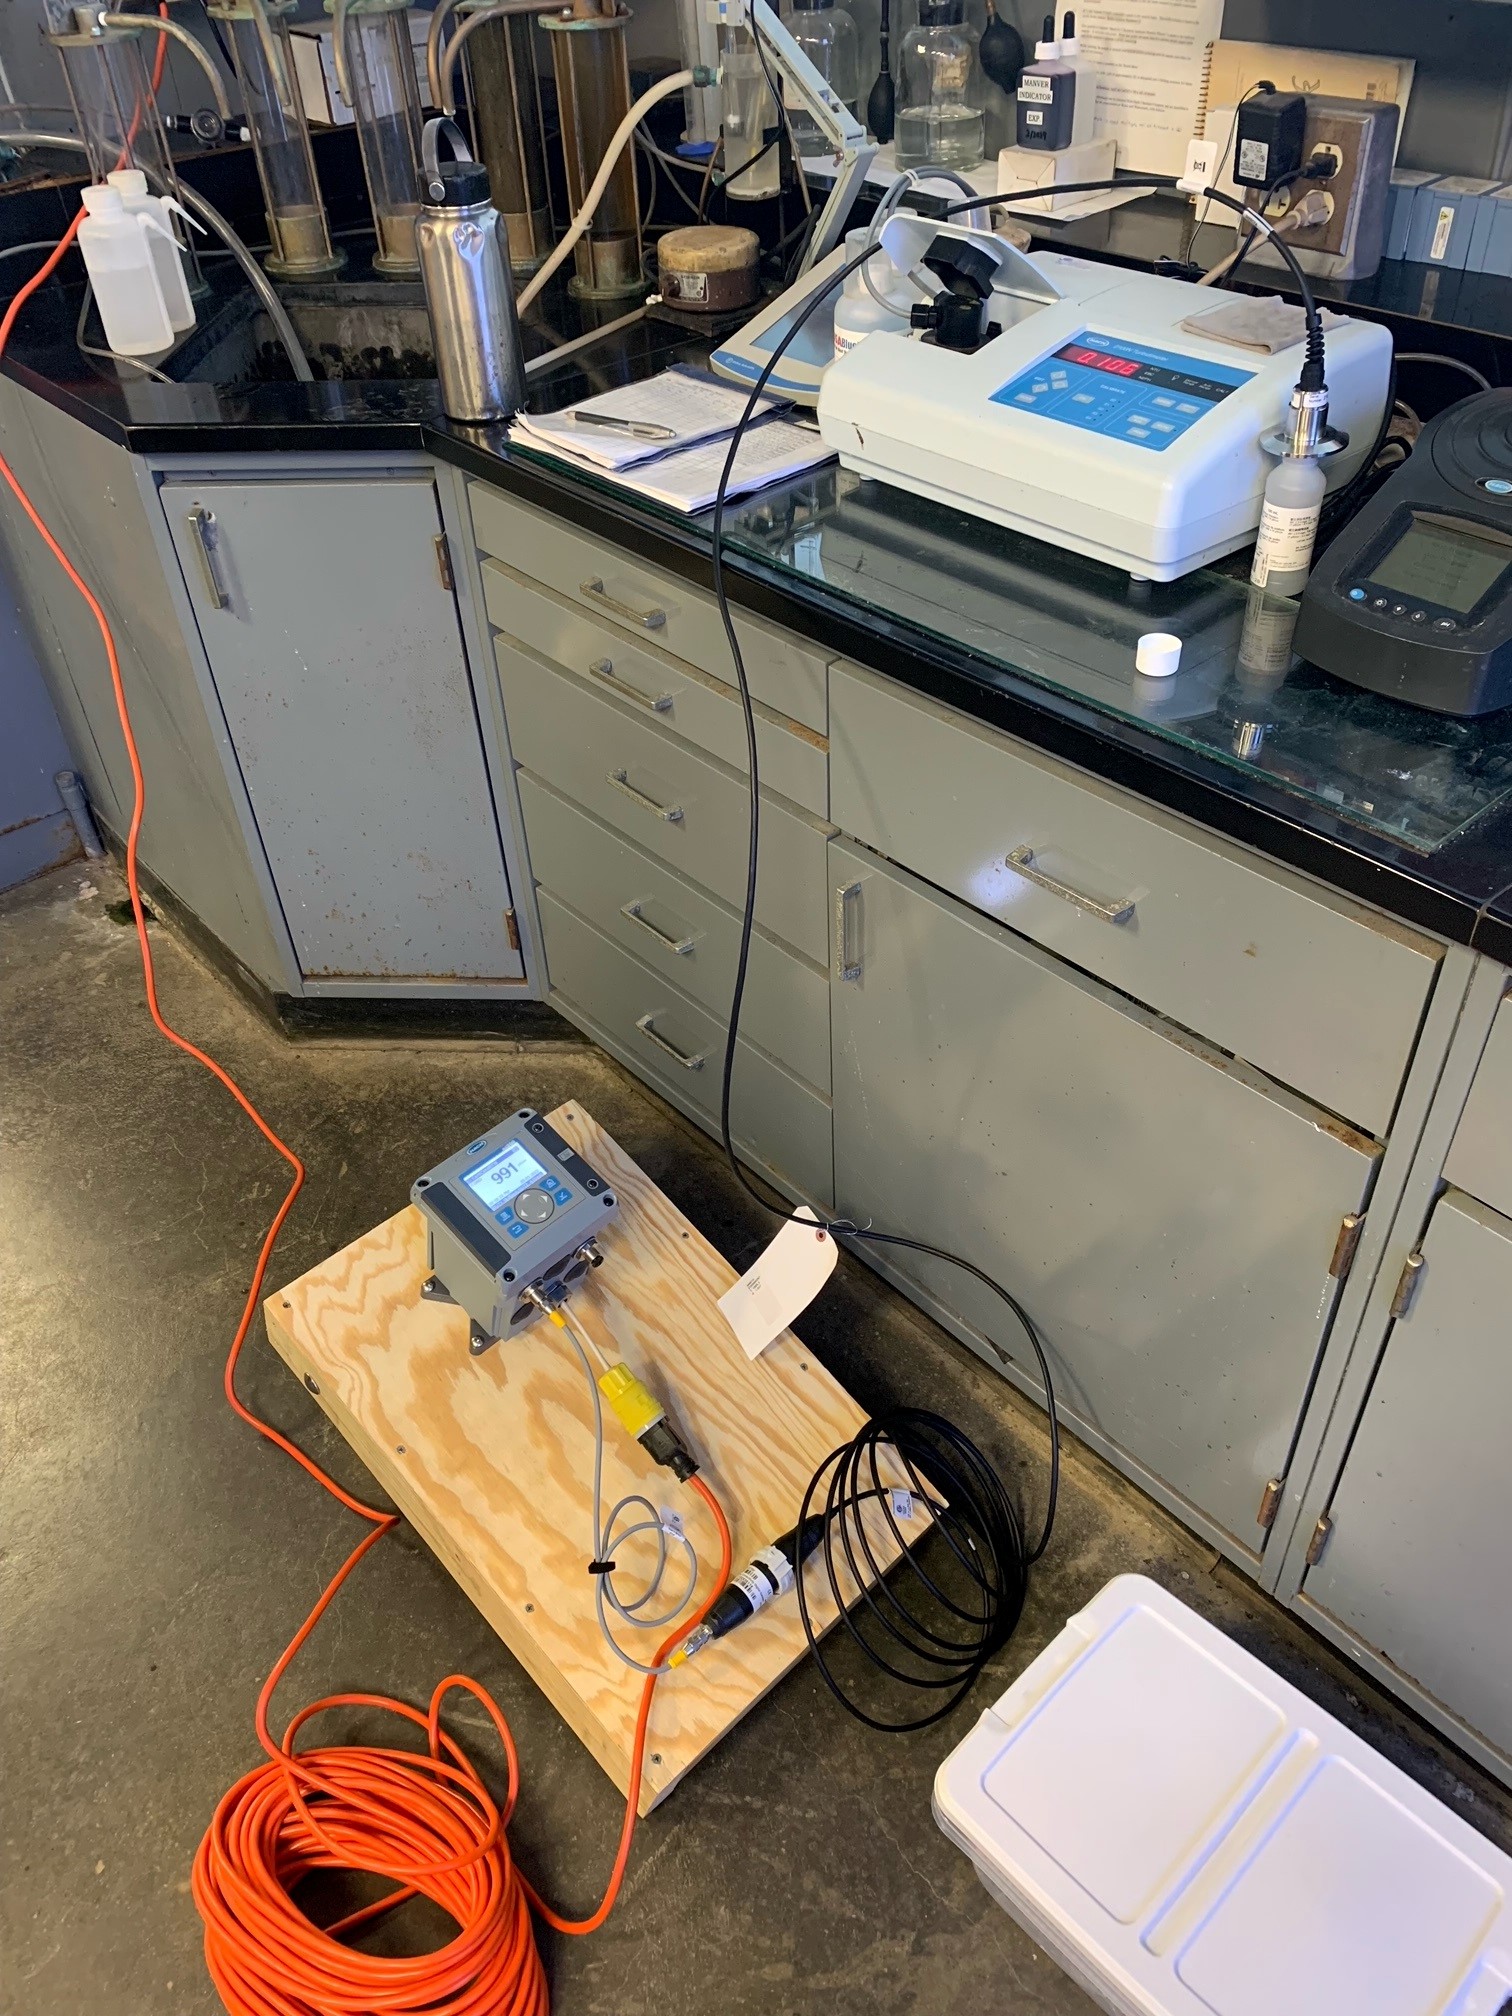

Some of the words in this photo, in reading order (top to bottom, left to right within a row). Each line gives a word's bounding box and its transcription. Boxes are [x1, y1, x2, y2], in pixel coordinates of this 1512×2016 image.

[1024, 79, 1049, 88] MANVER
[1019, 91, 1052, 101] INDICATOR
[491, 1162, 518, 1185] 991
